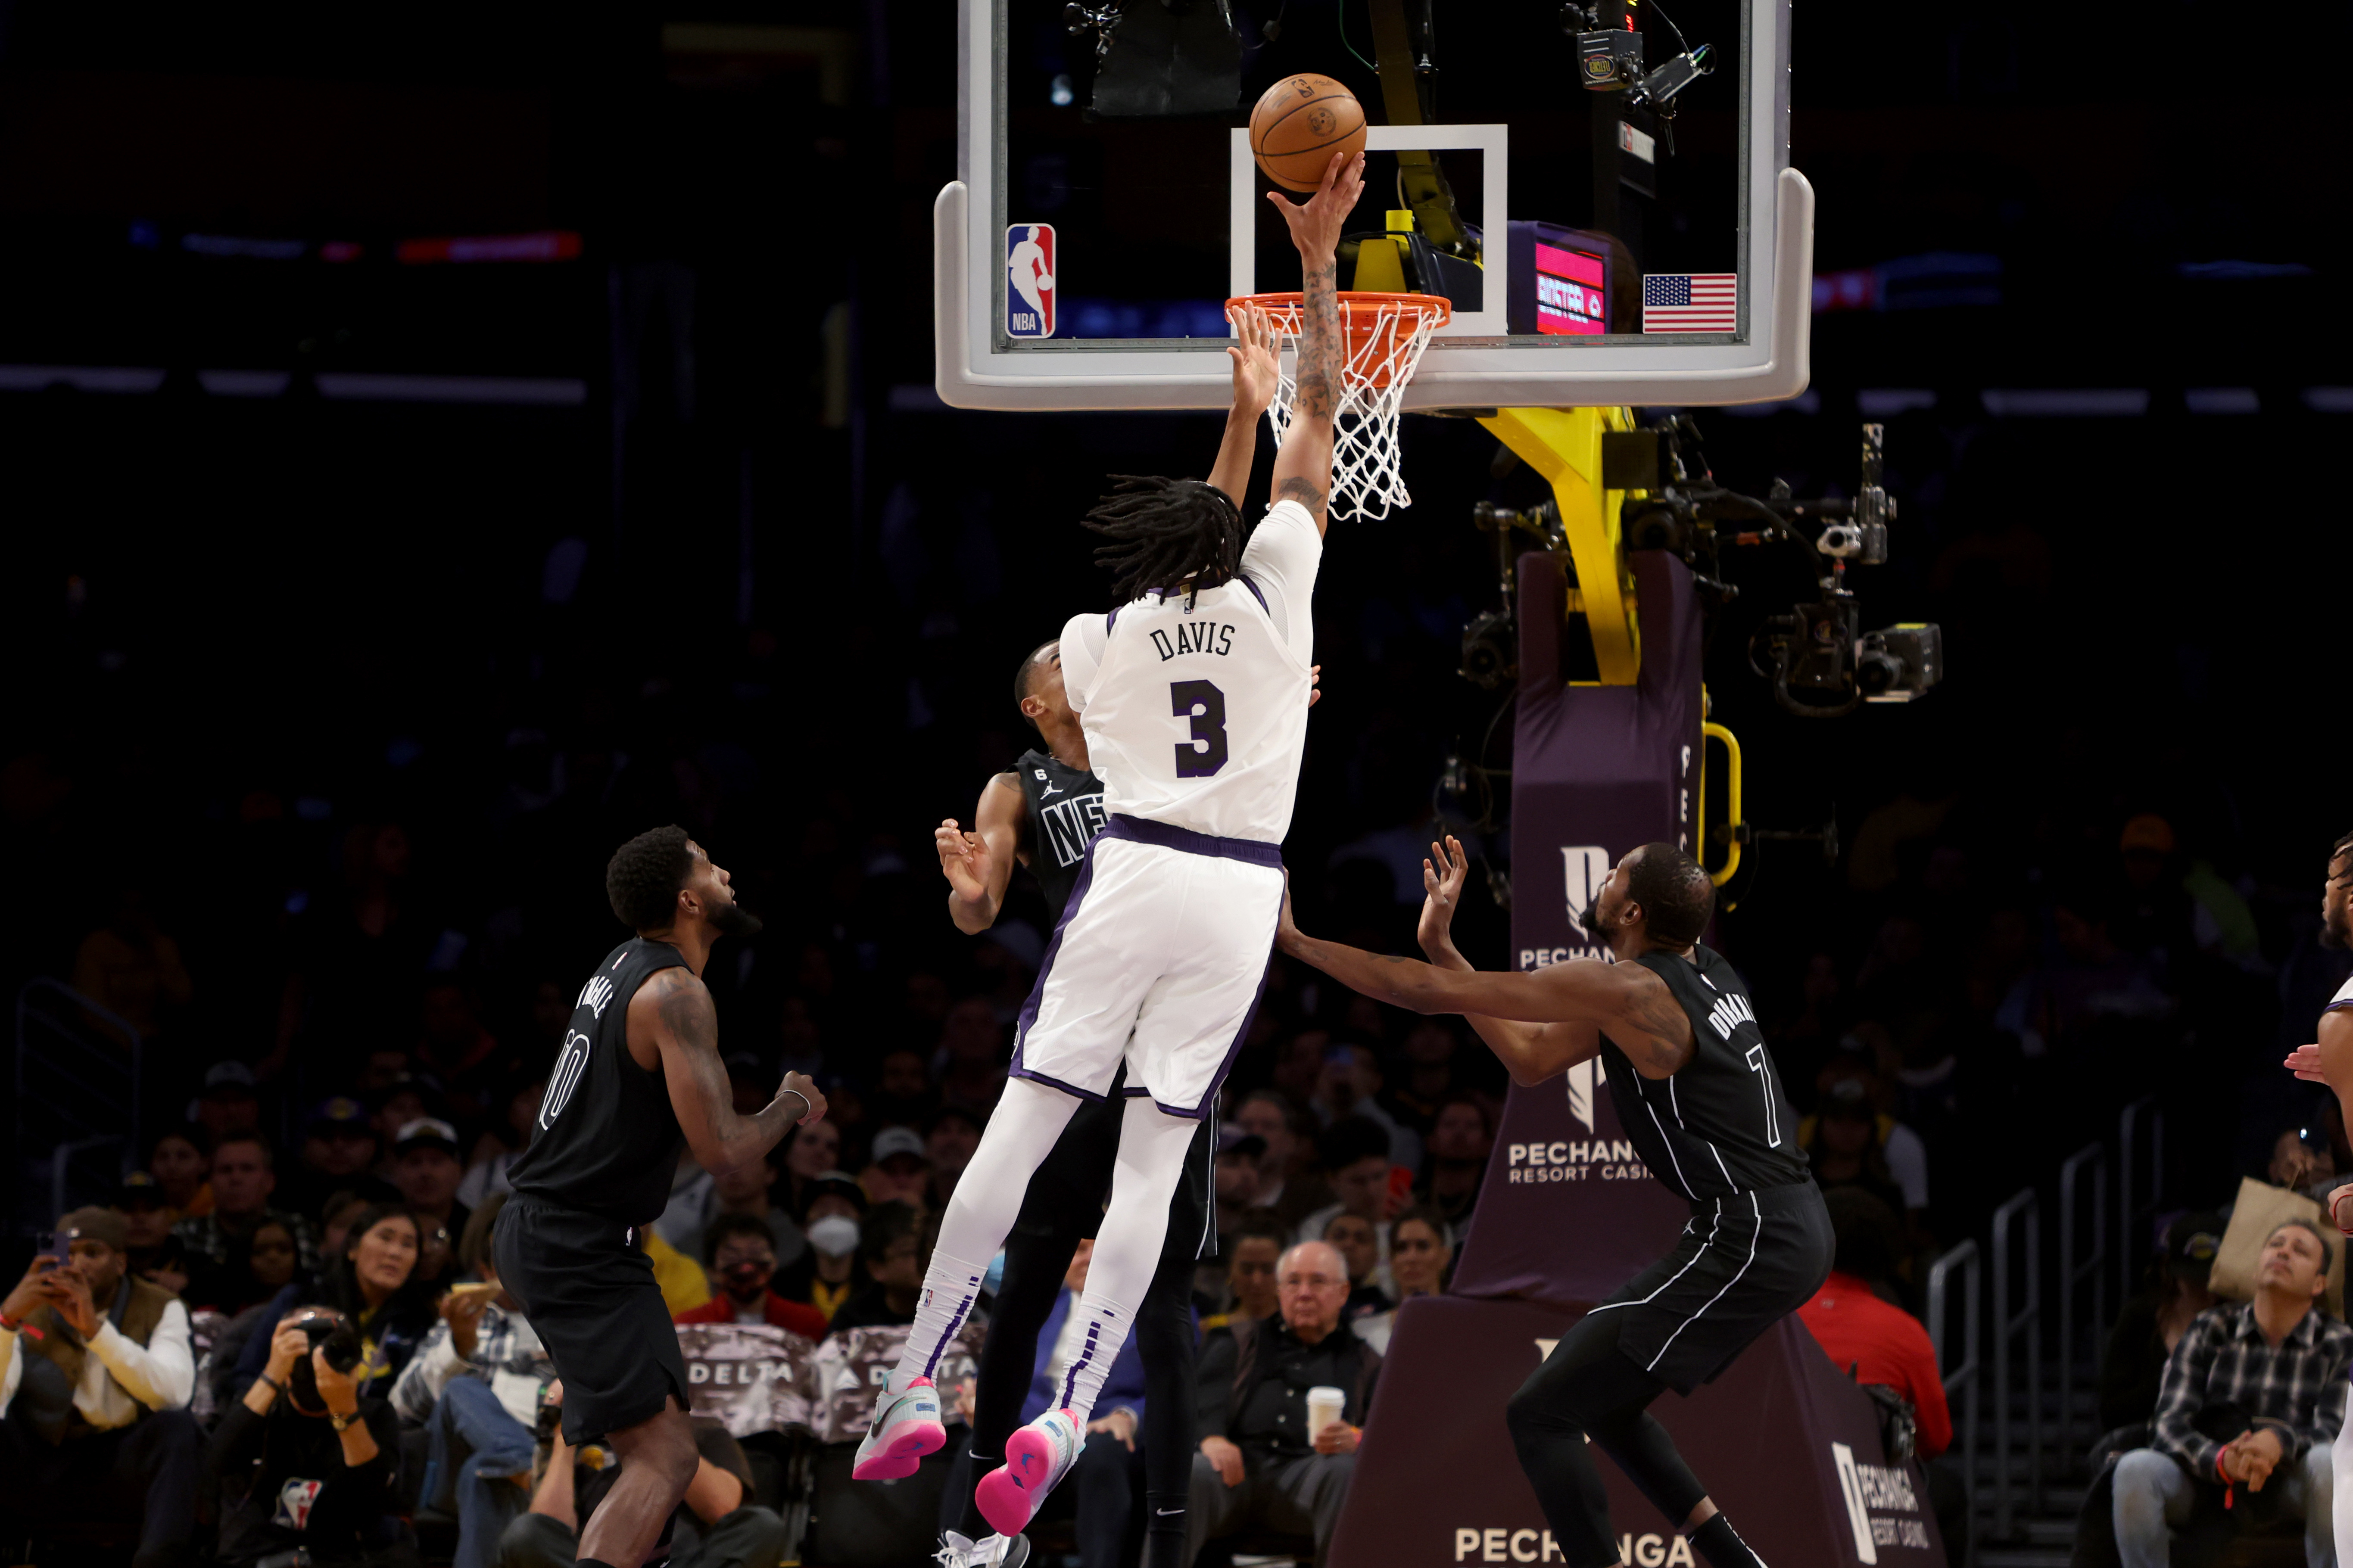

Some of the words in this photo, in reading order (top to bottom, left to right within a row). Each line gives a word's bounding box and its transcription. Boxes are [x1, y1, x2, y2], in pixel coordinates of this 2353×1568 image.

[1013, 313, 1036, 331] NBA
[1150, 622, 1235, 662] DAVIS
[1170, 679, 1228, 778] 3
[1035, 769, 1047, 780] 6
[1041, 792, 1111, 868] NE
[1520, 946, 1616, 969] PECHAN
[1745, 1042, 1782, 1148] 7
[1509, 1139, 1641, 1167] PECHAN
[1509, 1165, 1590, 1184] RESORT
[1601, 1164, 1655, 1180] CASI
[689, 1362, 794, 1384] DELTA
[869, 1358, 978, 1385] DTA
[1455, 1528, 1696, 1567] PECHNGA
